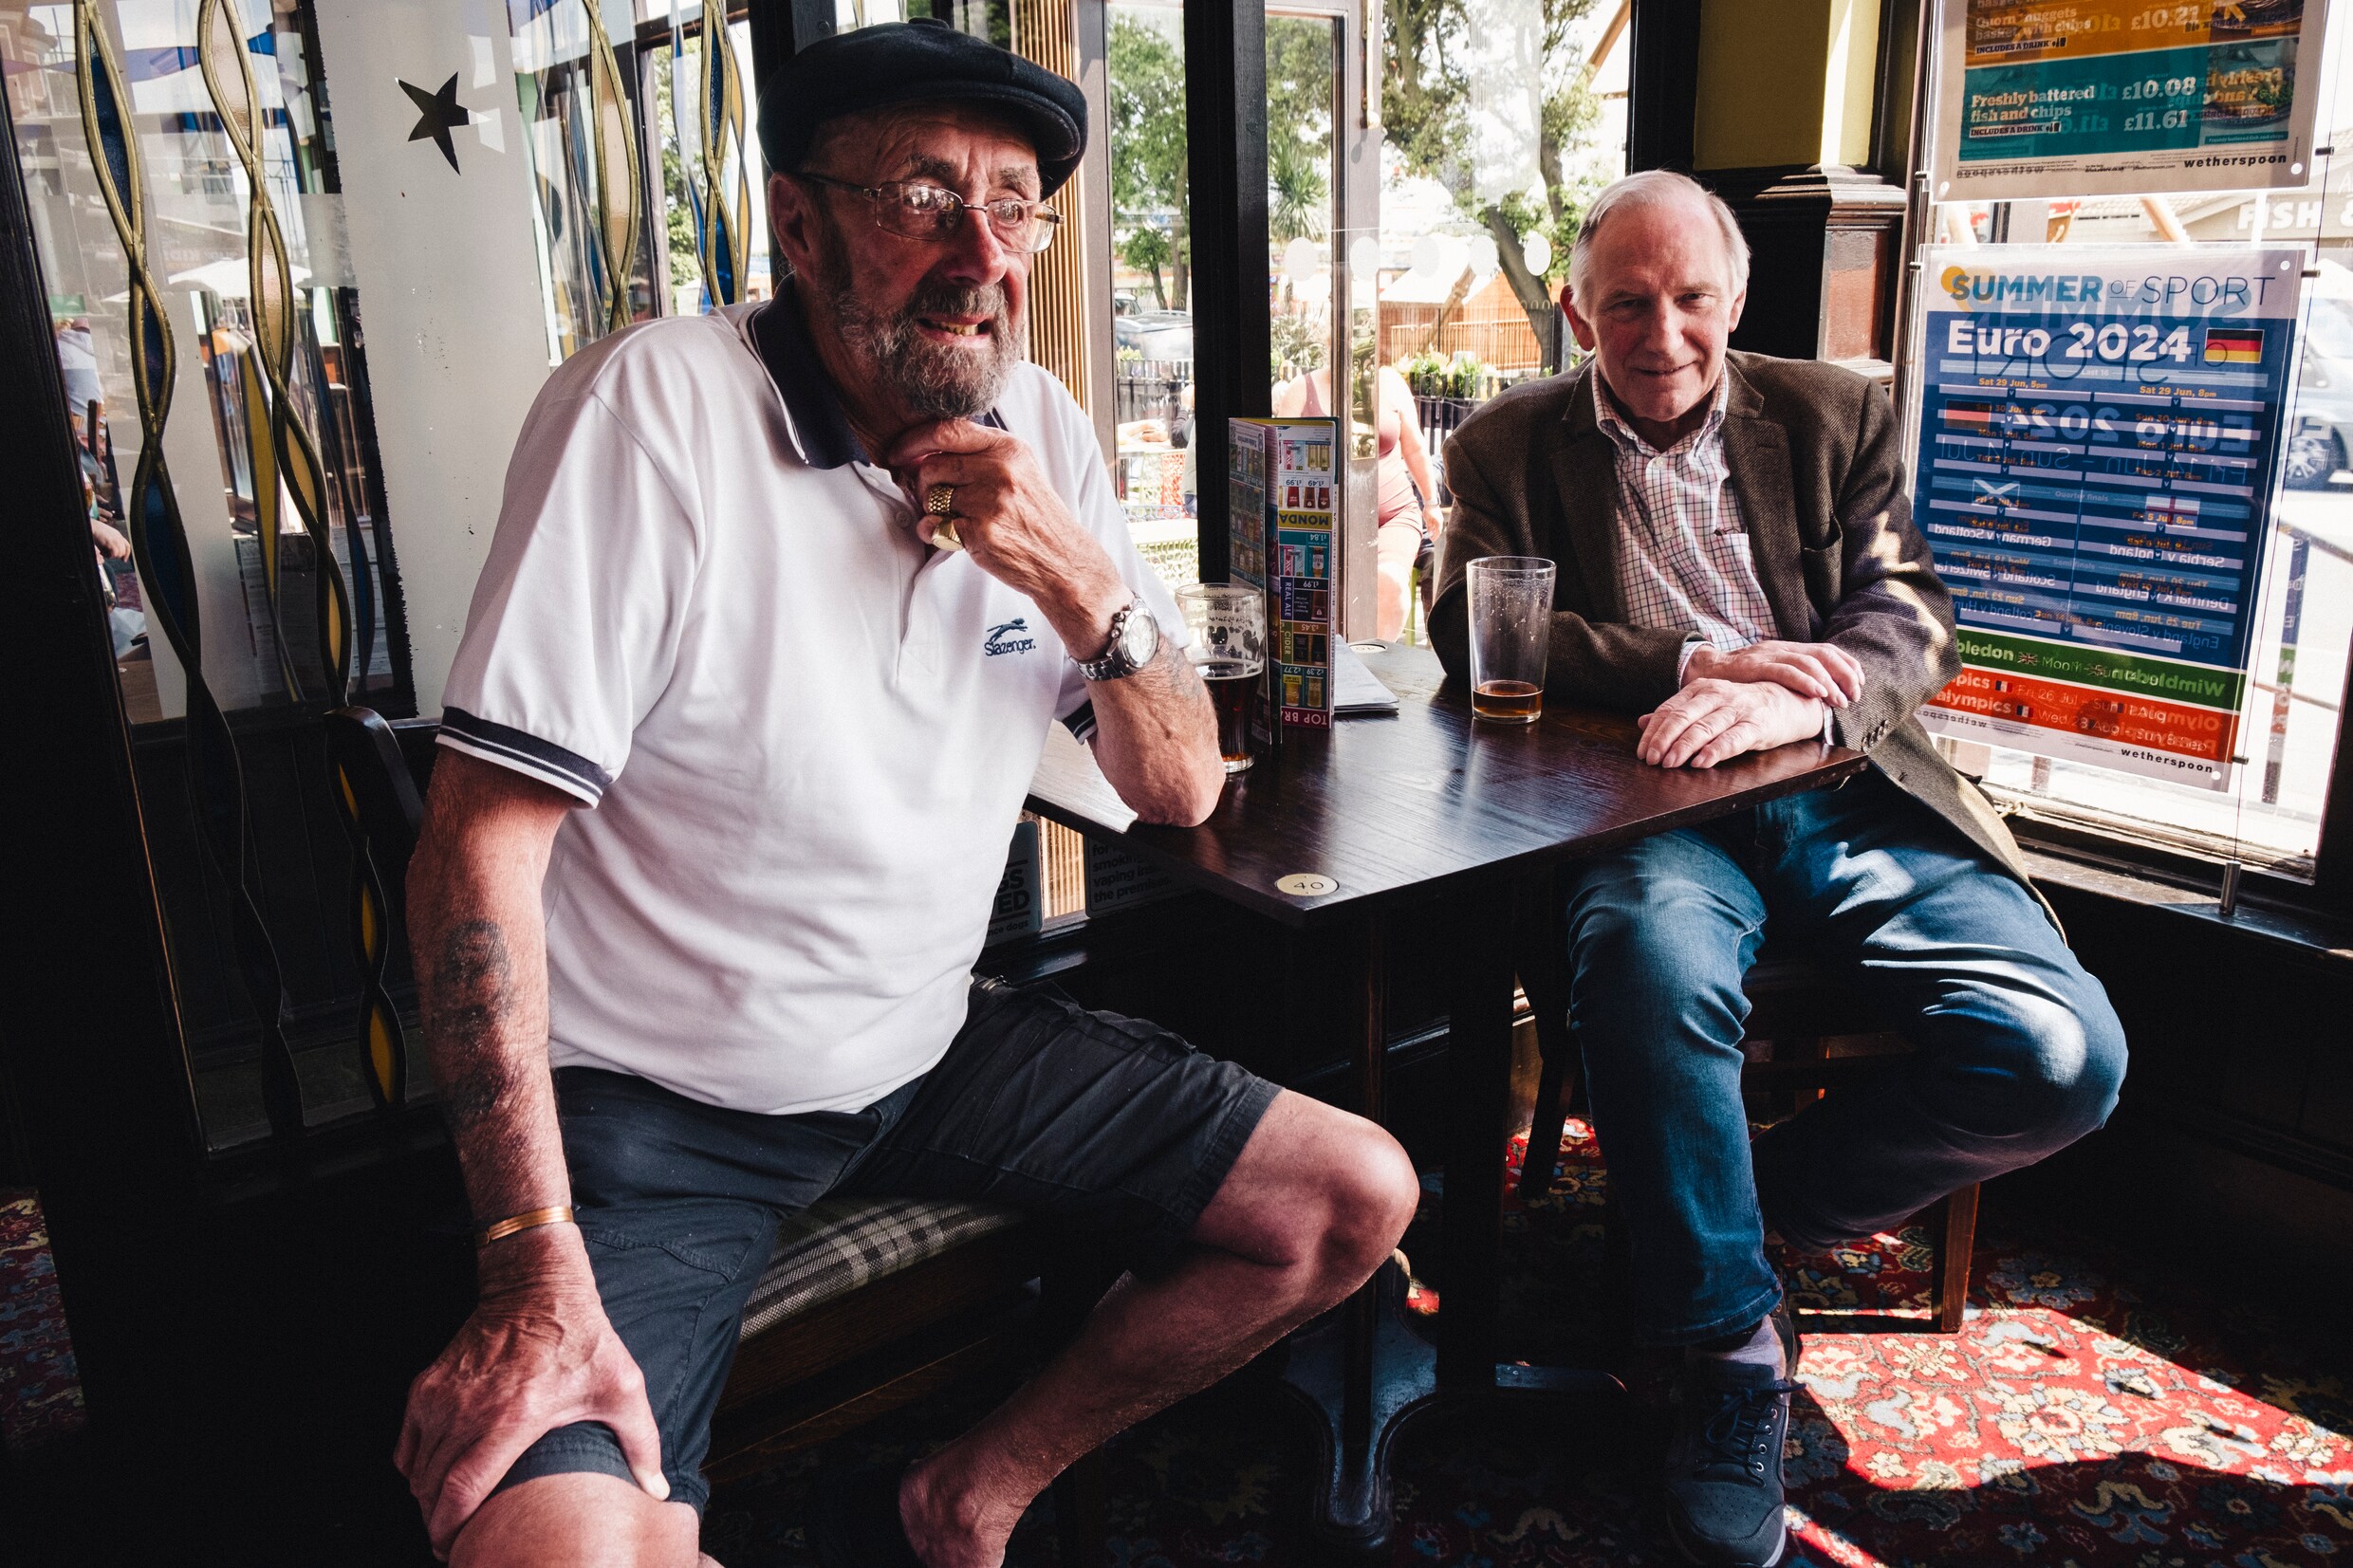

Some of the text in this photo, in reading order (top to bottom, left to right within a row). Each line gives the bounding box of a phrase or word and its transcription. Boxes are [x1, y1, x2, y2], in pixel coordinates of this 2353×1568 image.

[2025, 8, 2077, 23] nuggets
[2131, 6, 2199, 30] £10.21
[1976, 43, 2015, 54] INCLUDES
[2024, 40, 2049, 50] DRINK
[1971, 91, 2028, 107] Freshly
[2029, 85, 2095, 103] battered
[2122, 77, 2196, 101] £10.08
[1971, 105, 2072, 122] fish and chips
[2124, 110, 2188, 132] £11.61
[1971, 126, 2010, 137] INCLUDES
[2017, 124, 2043, 134] DRINK
[2184, 155, 2288, 168] wetherspoon
[1951, 275, 2276, 305] SUMMER OF SPORT
[1948, 320, 2192, 362] Euro 2024
[2030, 380, 2047, 389] 5pm
[2140, 386, 2216, 398] Sat 29 Jun, 8pm
[1278, 513, 1329, 526] MONDA
[984, 638, 1035, 656] Slazenger
[1957, 638, 2014, 661] bledon
[1952, 673, 1990, 690] pics
[1937, 688, 2011, 713] alympics
[1281, 711, 1327, 726] TOP BR
[2121, 748, 2214, 773] wetherspoon
[1294, 881, 1325, 890] 40
[1094, 889, 1114, 903] the
